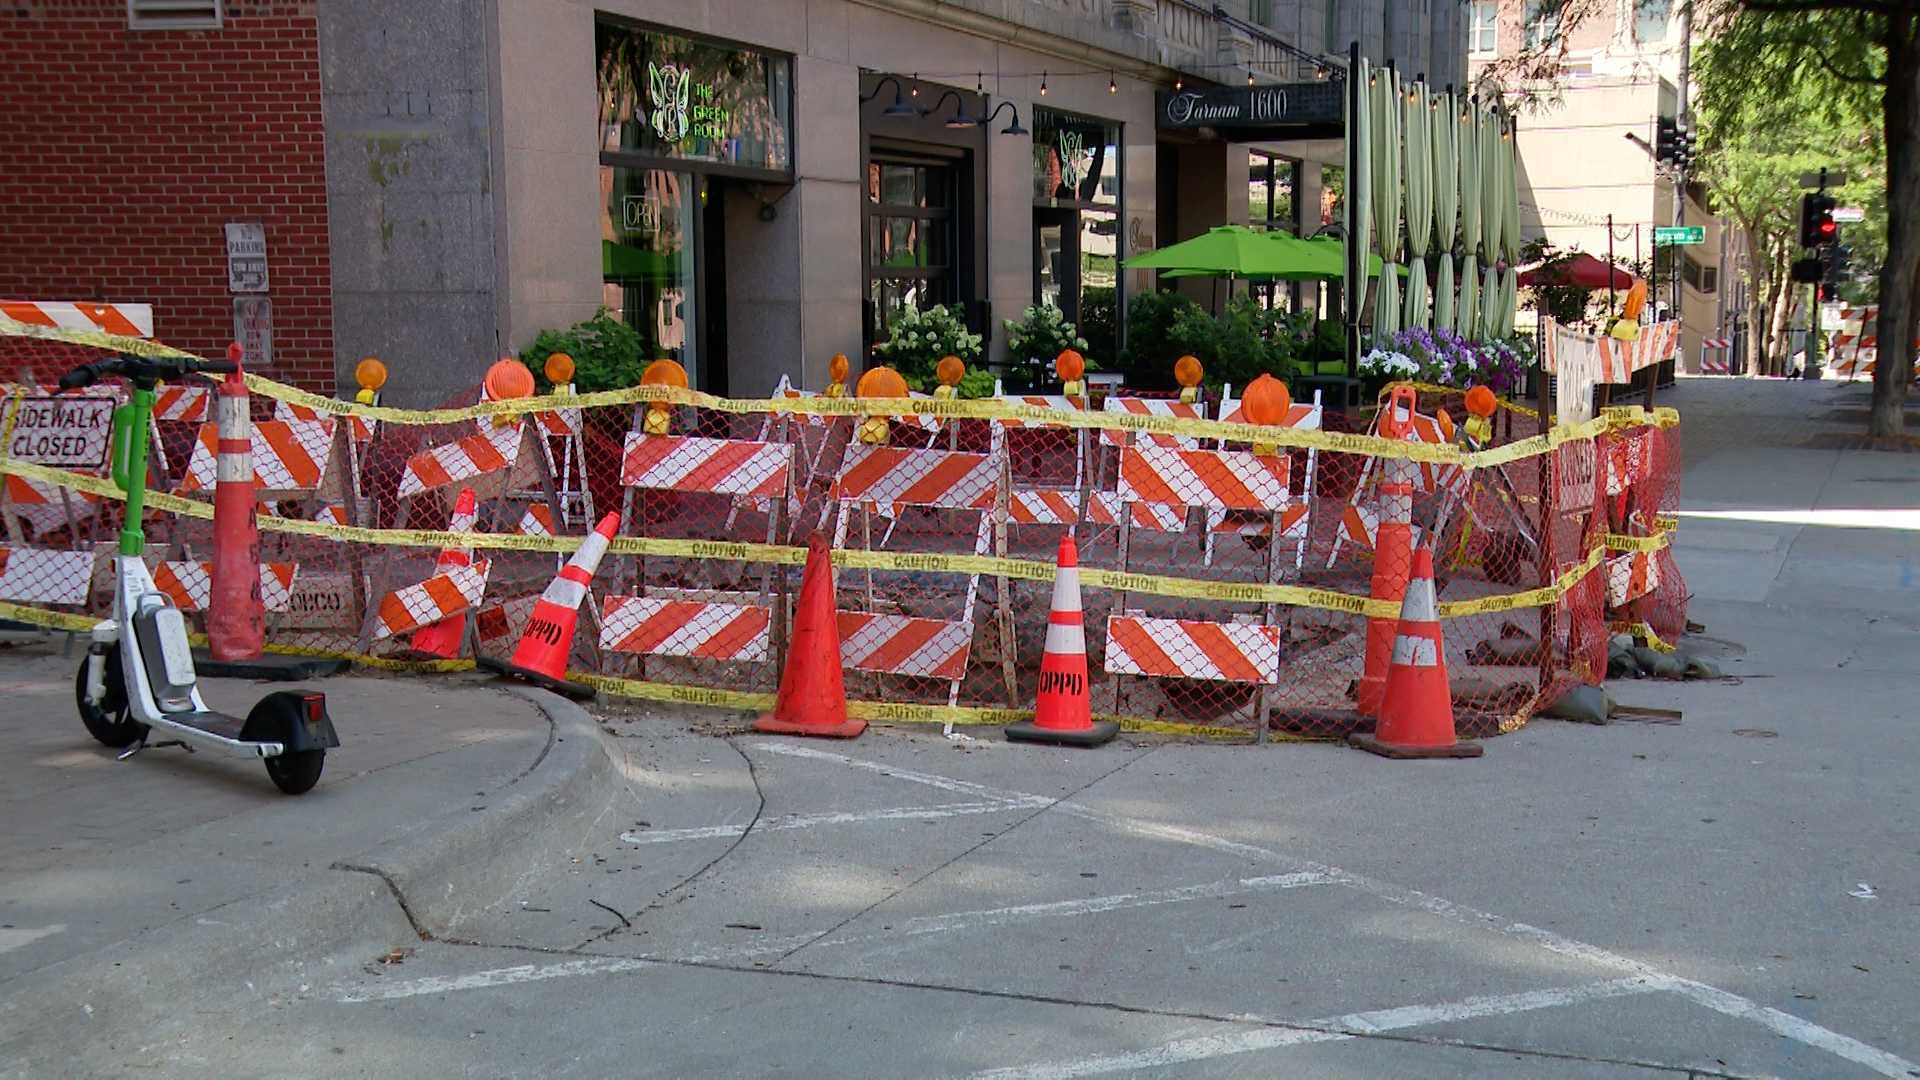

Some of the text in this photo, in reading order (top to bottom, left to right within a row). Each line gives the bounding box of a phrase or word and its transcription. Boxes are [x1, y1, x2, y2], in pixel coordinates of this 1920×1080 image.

[693, 104, 729, 122] GREEN
[1249, 88, 1287, 121] 1600
[693, 123, 725, 139] ROOM
[627, 201, 657, 226] OPEN
[912, 401, 968, 414] CAUTION
[13, 435, 87, 457] CLOSED
[692, 543, 747, 558] CAUTION
[894, 555, 950, 570] CAUTION
[996, 562, 1055, 579] CAUTION
[1102, 574, 1160, 592] CAUTION
[1206, 584, 1263, 599] CAUTION
[1308, 591, 1365, 612] CAUTION
[1041, 671, 1083, 696] OPPD
[672, 688, 728, 704] CAUTION
[877, 706, 933, 720] CAUTION
